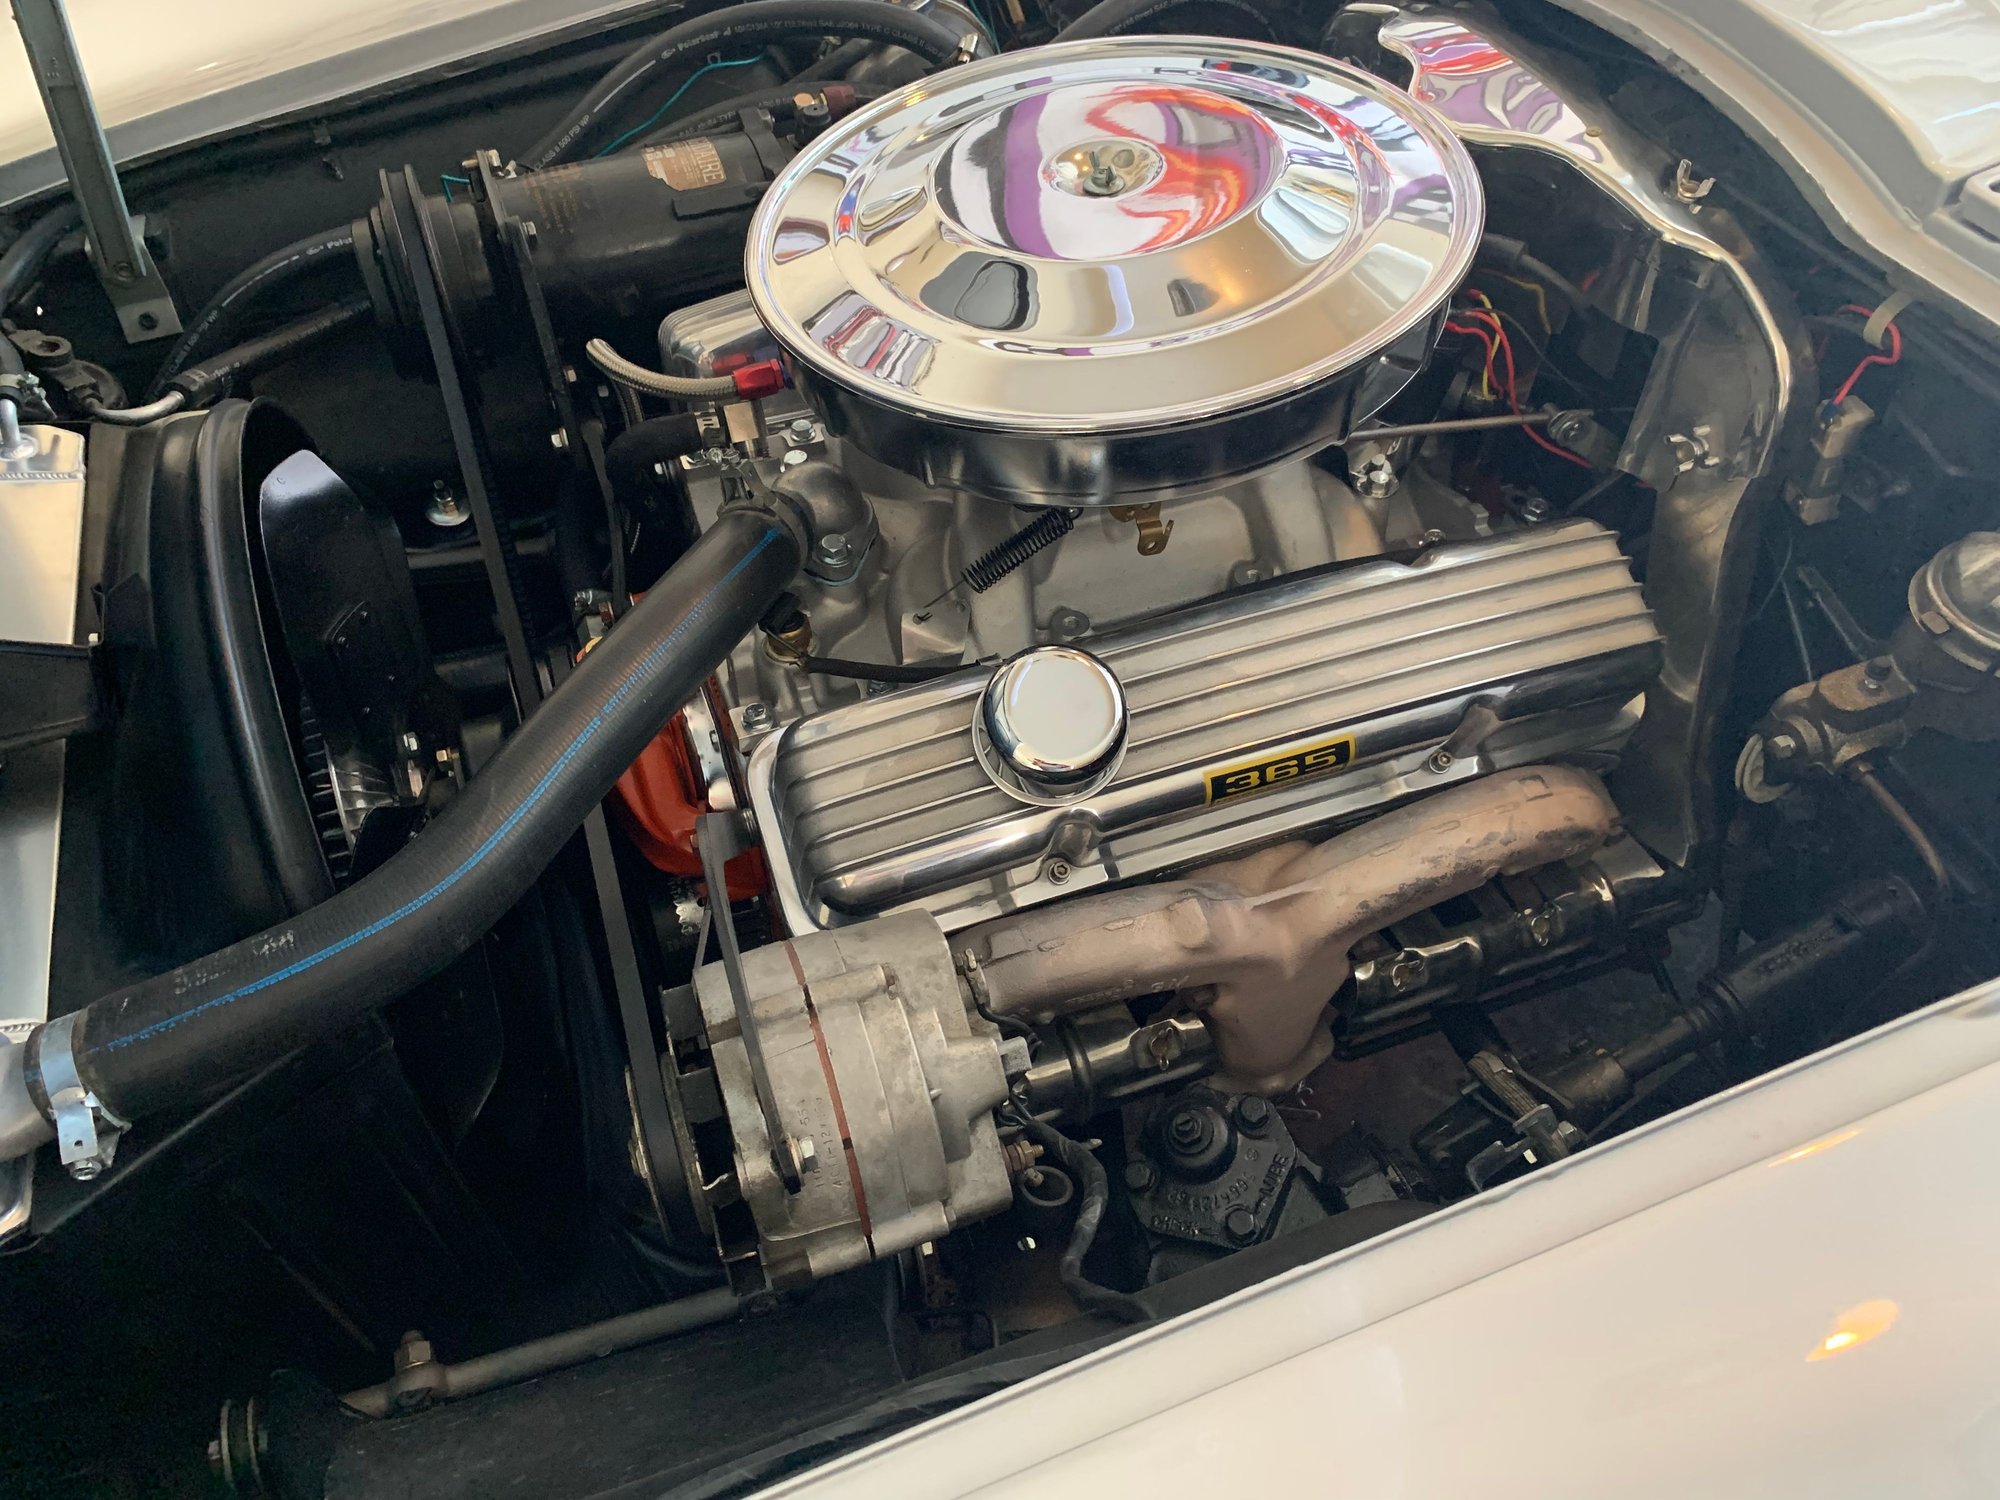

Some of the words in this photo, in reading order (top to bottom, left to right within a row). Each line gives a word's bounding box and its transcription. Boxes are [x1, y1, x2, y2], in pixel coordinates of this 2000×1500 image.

[557, 134, 571, 149] 500
[568, 124, 581, 138] PSI
[577, 113, 590, 128] WP
[1226, 747, 1337, 793] 365
